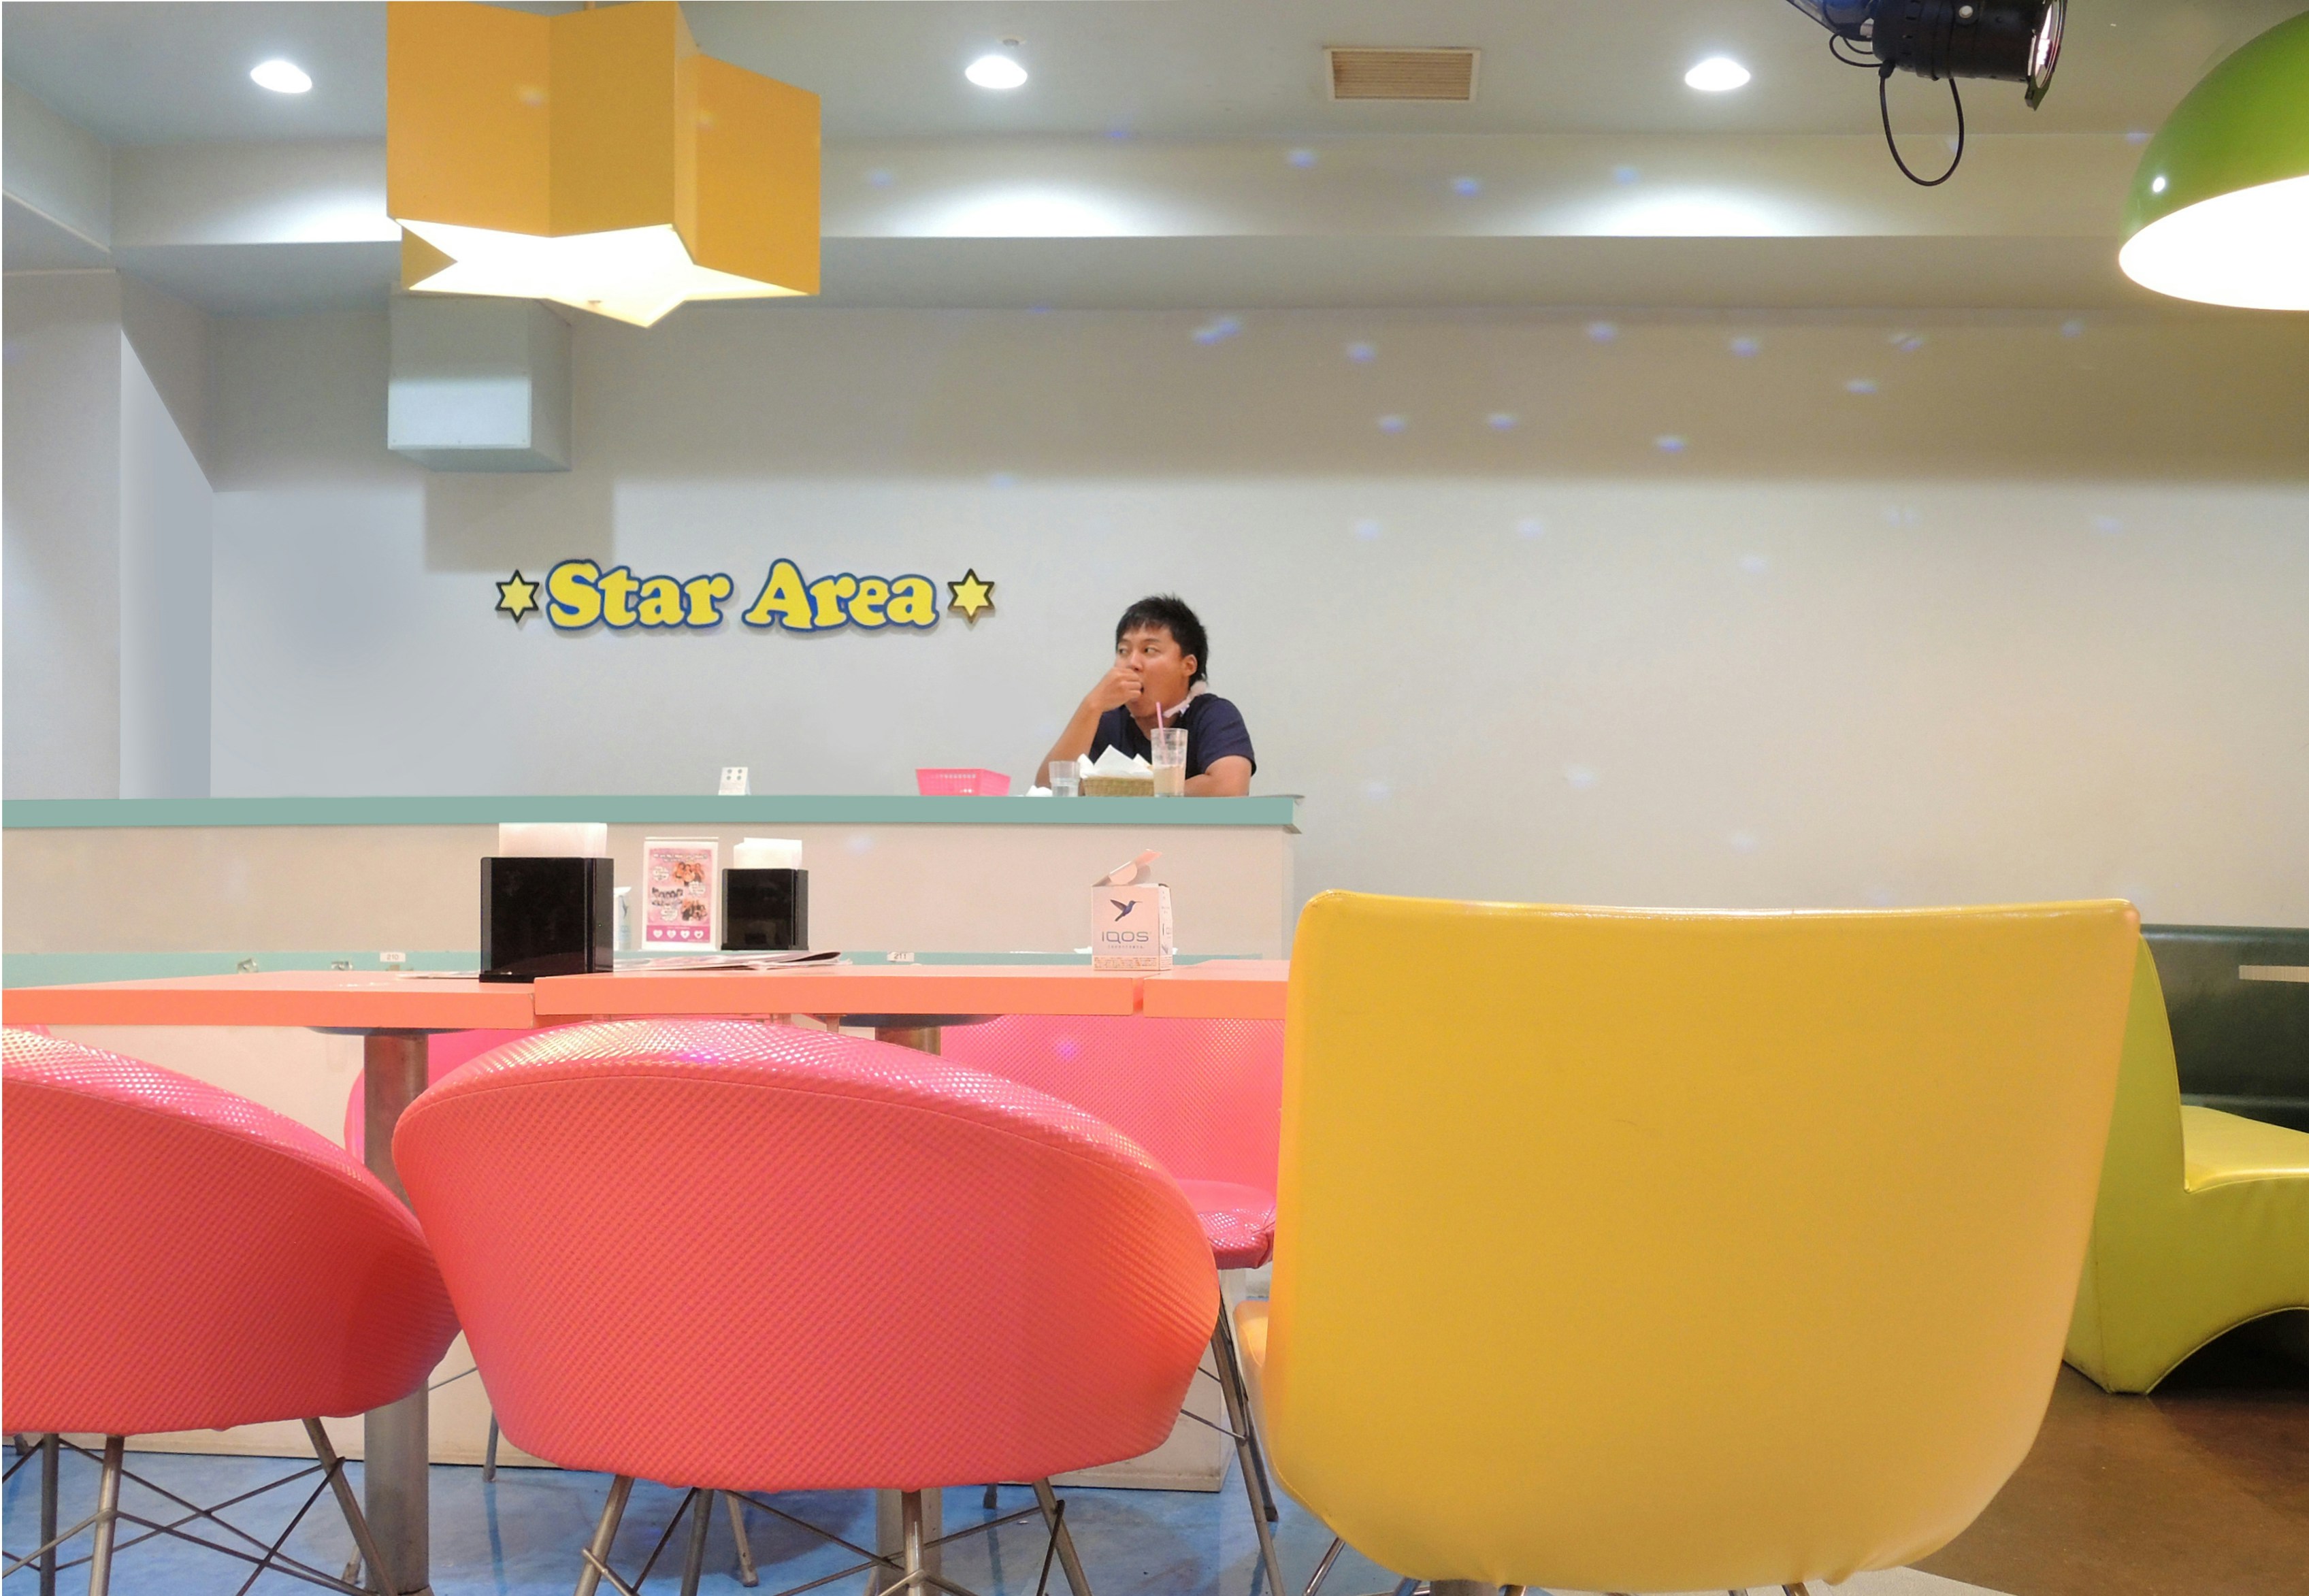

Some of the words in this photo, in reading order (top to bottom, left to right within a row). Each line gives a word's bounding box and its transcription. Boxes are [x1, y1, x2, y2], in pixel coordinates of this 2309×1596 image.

[545, 559, 734, 630] Star
[742, 558, 939, 632] Area
[1102, 931, 1149, 944] IQOS
